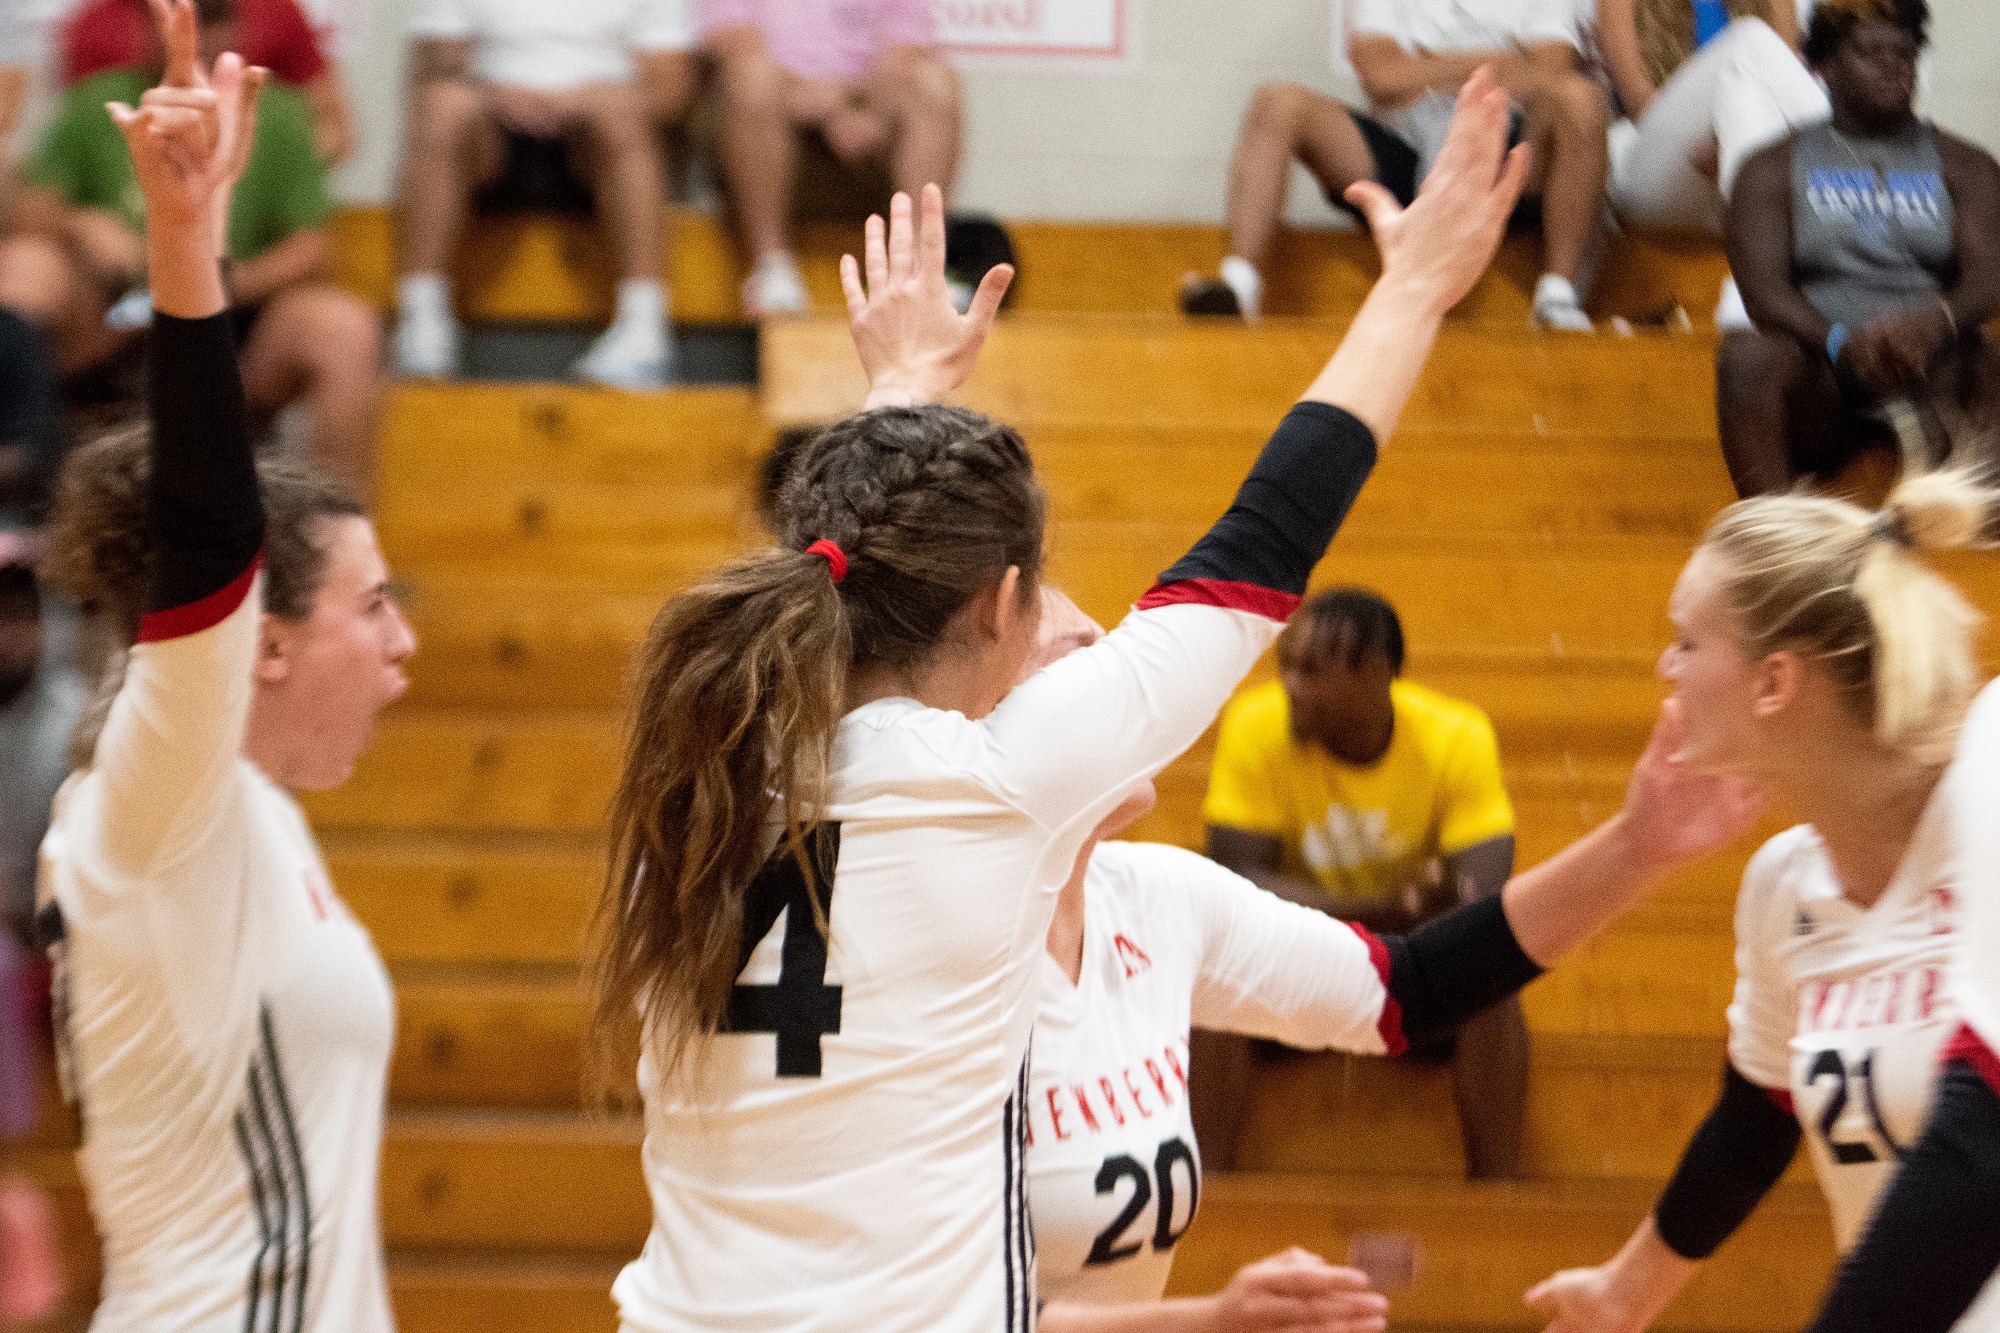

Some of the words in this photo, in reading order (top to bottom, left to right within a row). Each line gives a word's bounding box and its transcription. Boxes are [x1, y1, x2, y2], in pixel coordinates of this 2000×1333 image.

[702, 820, 844, 1079] 4
[1027, 1034, 1189, 1147] EWBERR
[1082, 1137, 1199, 1268] 20
